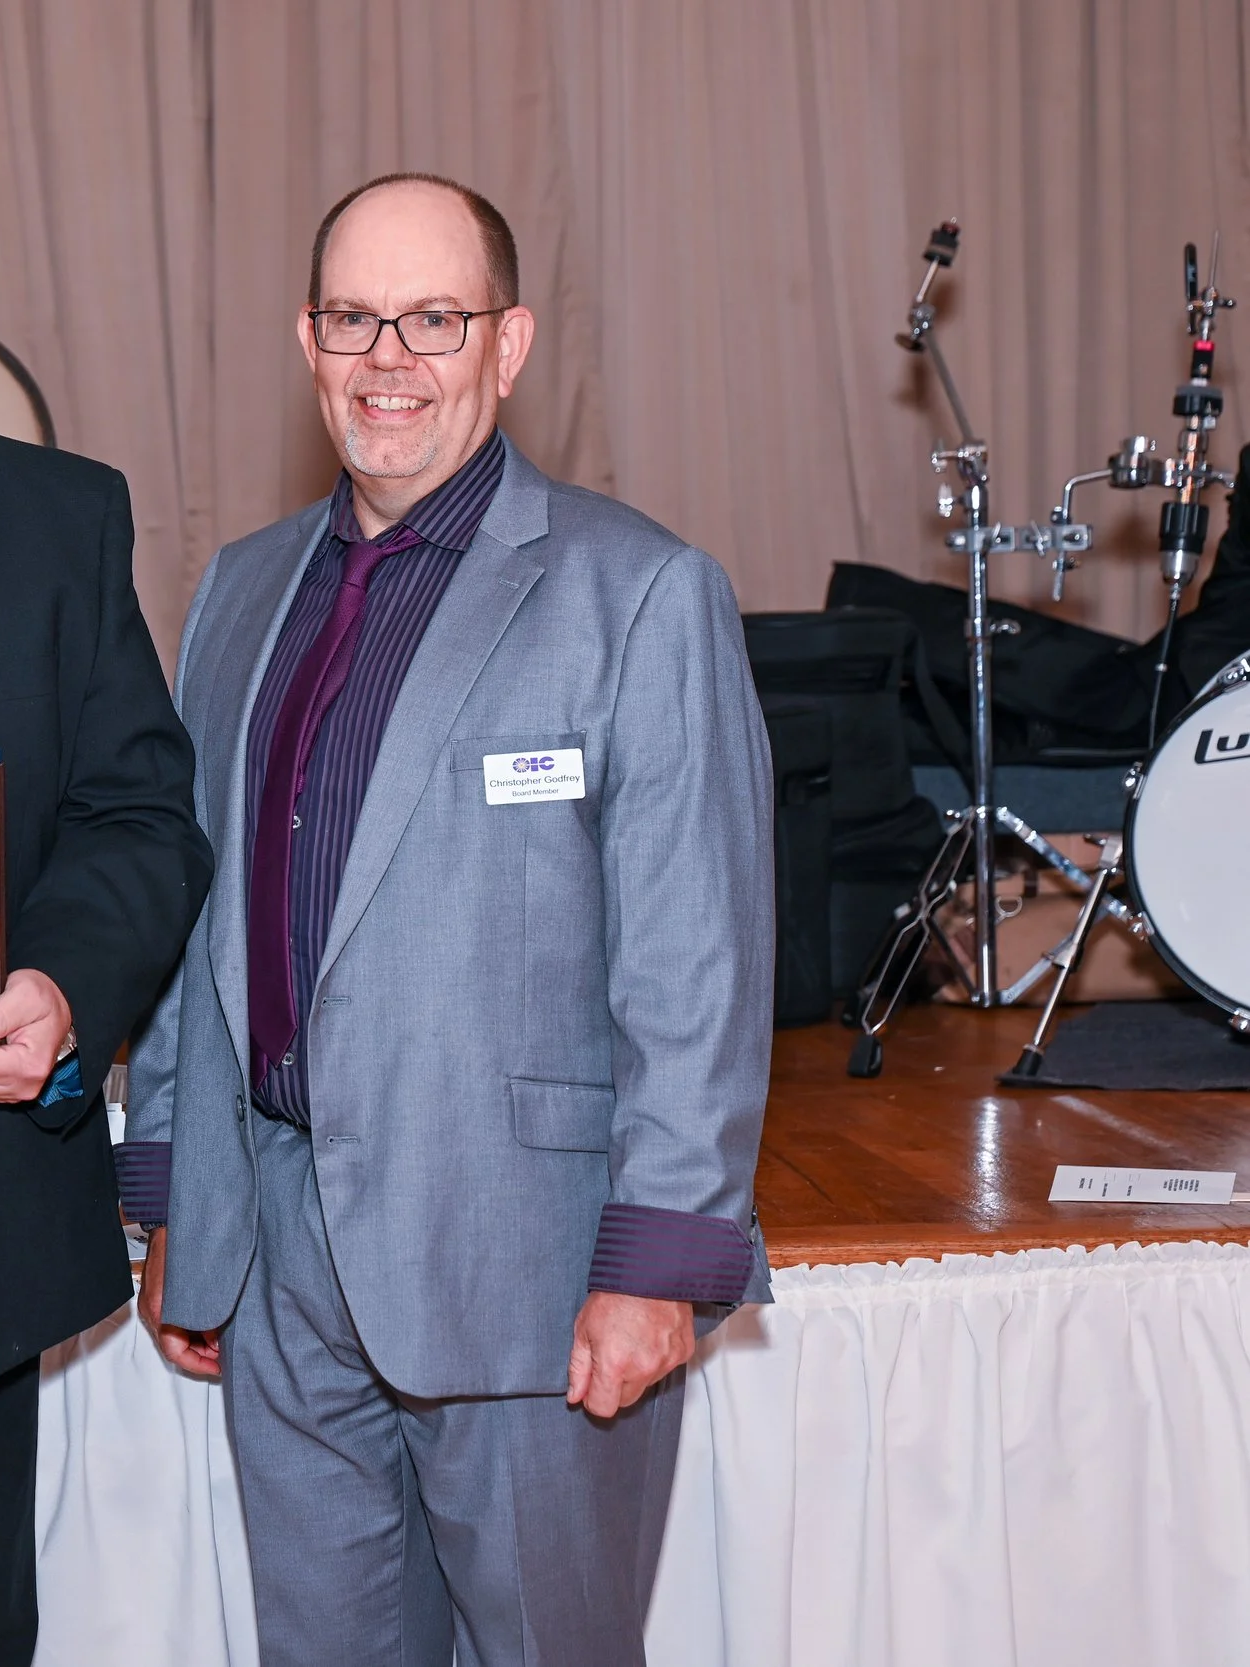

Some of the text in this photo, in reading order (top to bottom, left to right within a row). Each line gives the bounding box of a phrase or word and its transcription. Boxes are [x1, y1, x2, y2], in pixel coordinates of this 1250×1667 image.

[512, 756, 555, 773] OIC
[490, 774, 580, 788] Christopher Godfrey
[512, 788, 559, 797] Board Member
